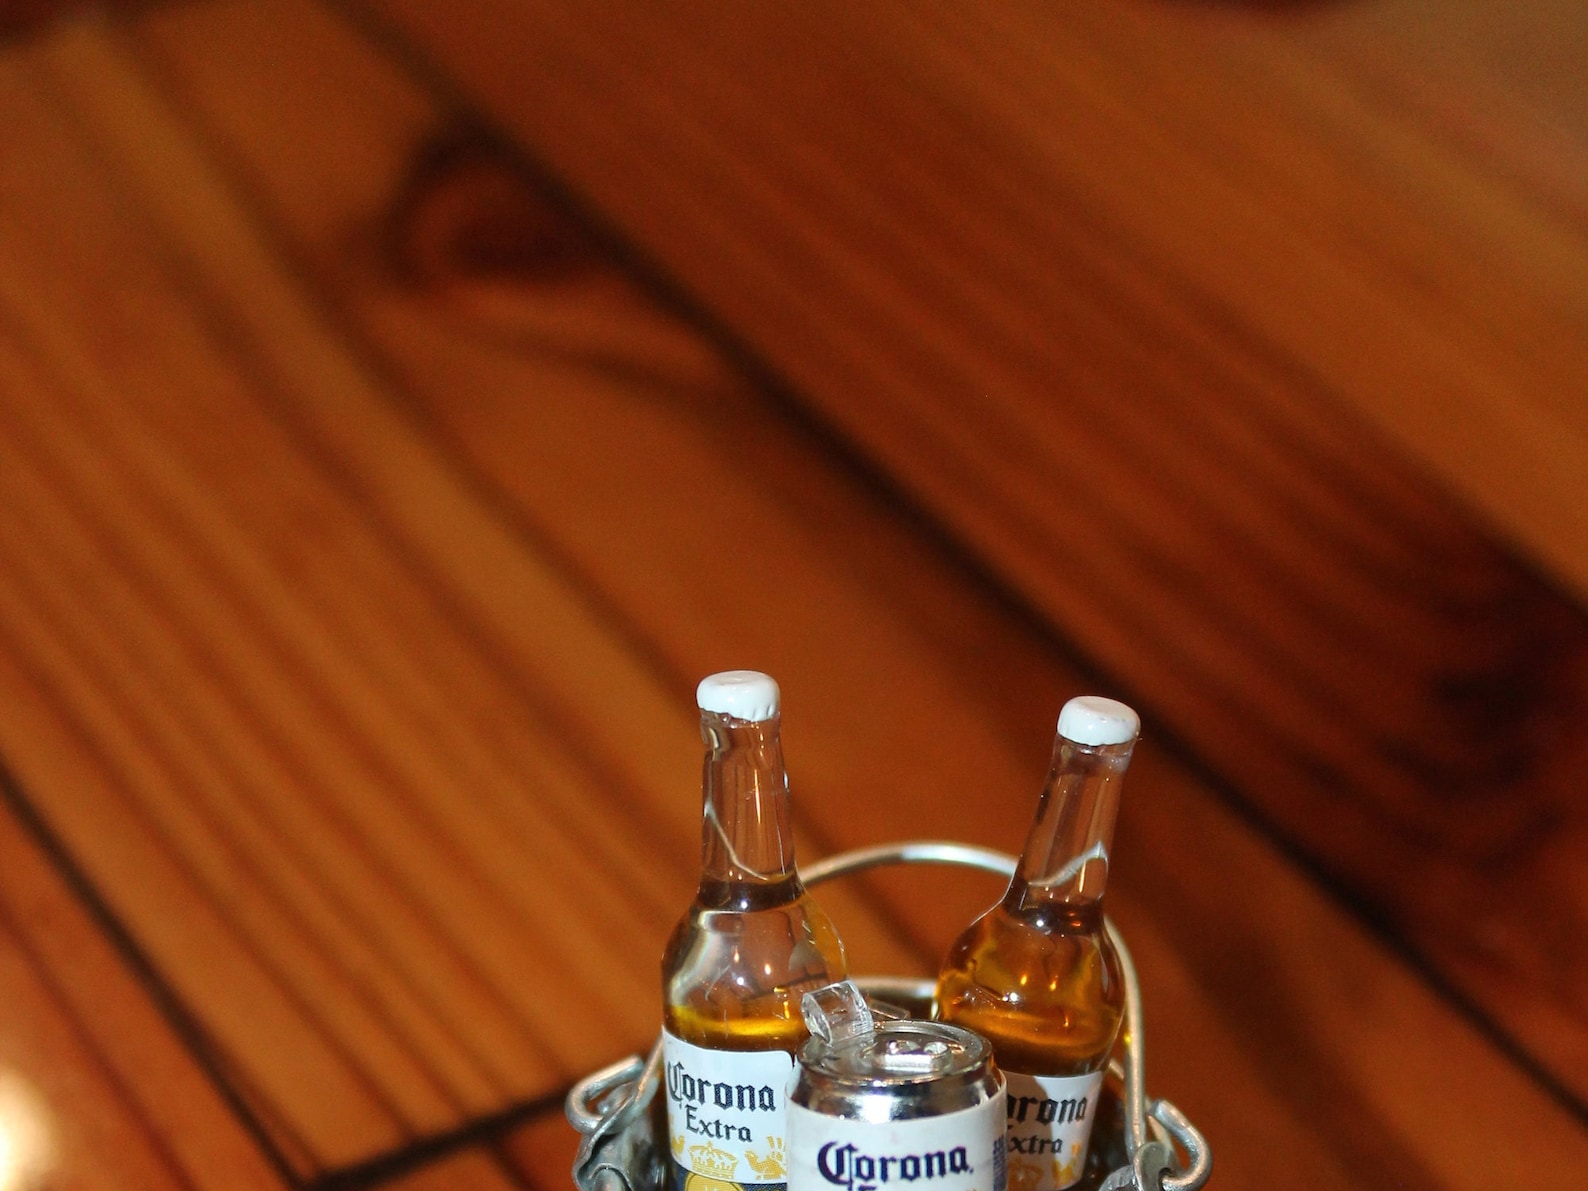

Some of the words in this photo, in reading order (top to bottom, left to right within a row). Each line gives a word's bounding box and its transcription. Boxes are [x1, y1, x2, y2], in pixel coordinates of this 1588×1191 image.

[667, 1061, 776, 1112] Corona
[684, 1104, 753, 1143] Extra
[1007, 1093, 1088, 1126] rona
[817, 1141, 971, 1191] Corona
